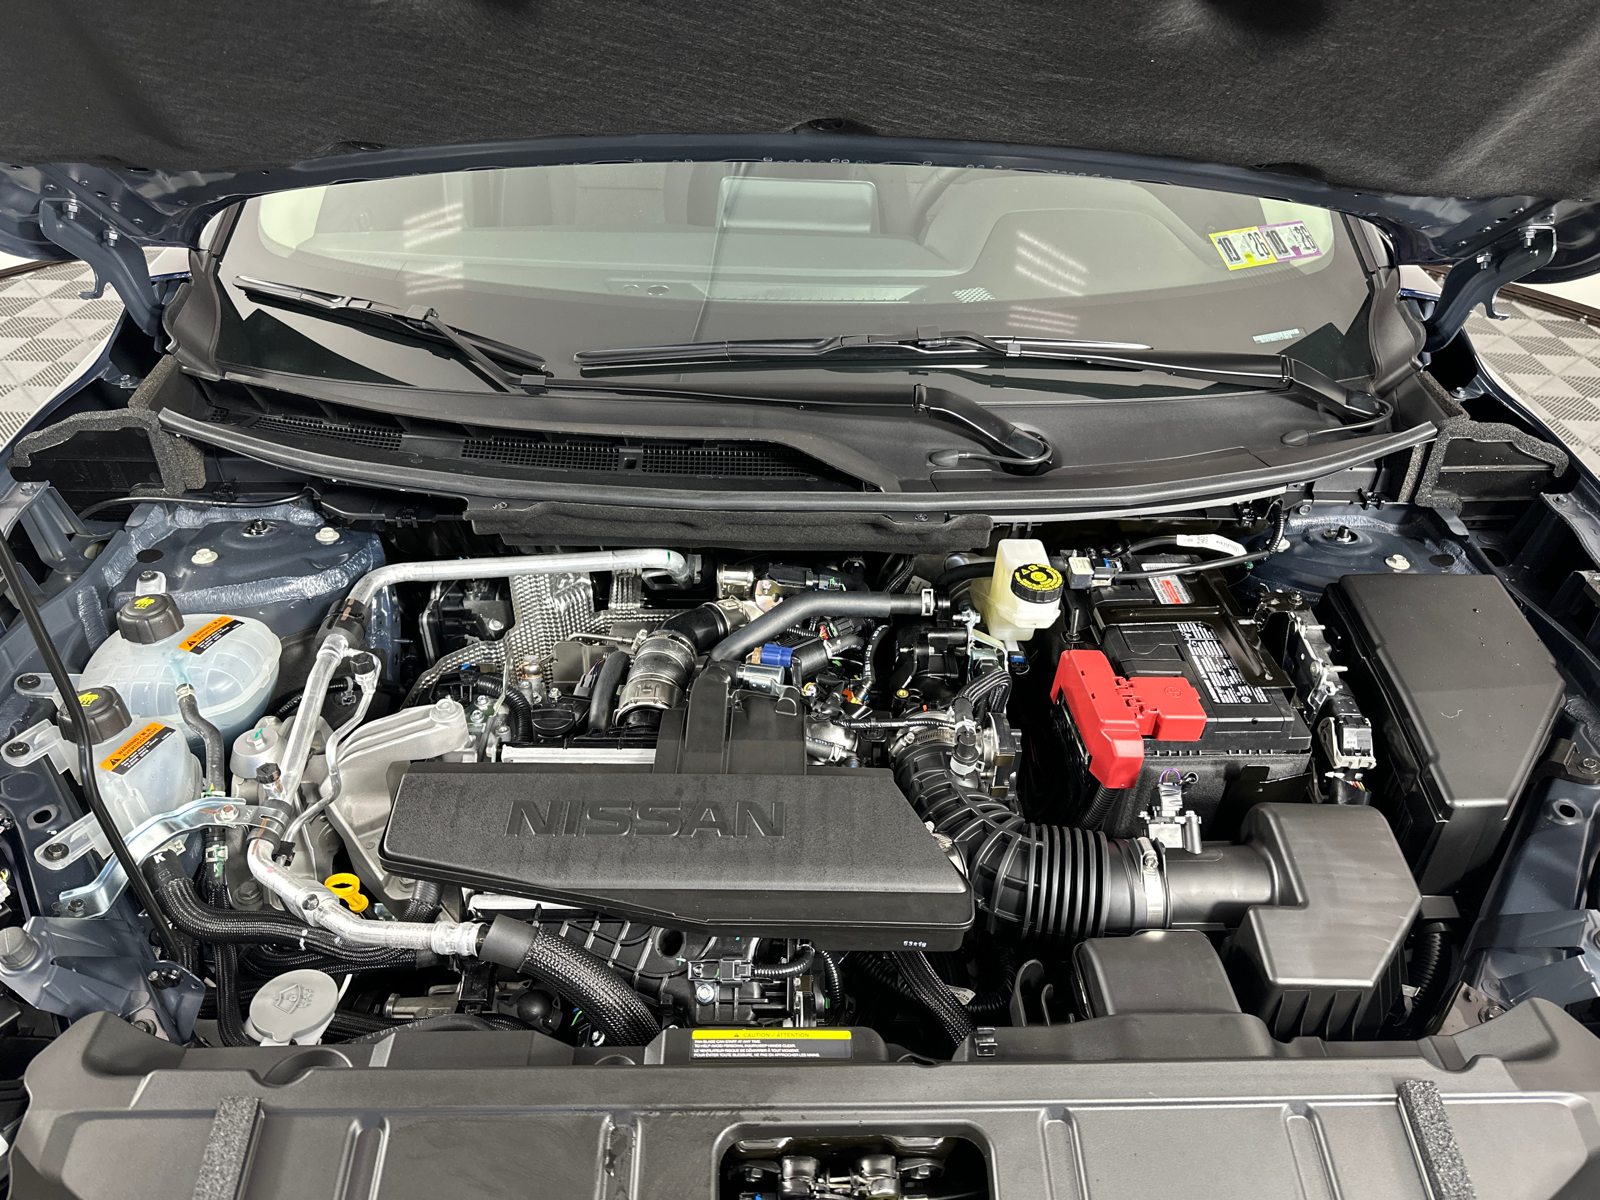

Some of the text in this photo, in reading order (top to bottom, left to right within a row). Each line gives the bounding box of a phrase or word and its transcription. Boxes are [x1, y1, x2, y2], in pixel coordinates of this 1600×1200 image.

[1217, 237, 1241, 262] 10
[1247, 231, 1271, 257] 26
[1265, 229, 1289, 255] 10
[1293, 225, 1317, 250] 26
[117, 737, 139, 755] WARNING
[122, 727, 158, 757] AVERTISSEMENT
[504, 801, 786, 838] NISSAN
[153, 852, 166, 864] K
